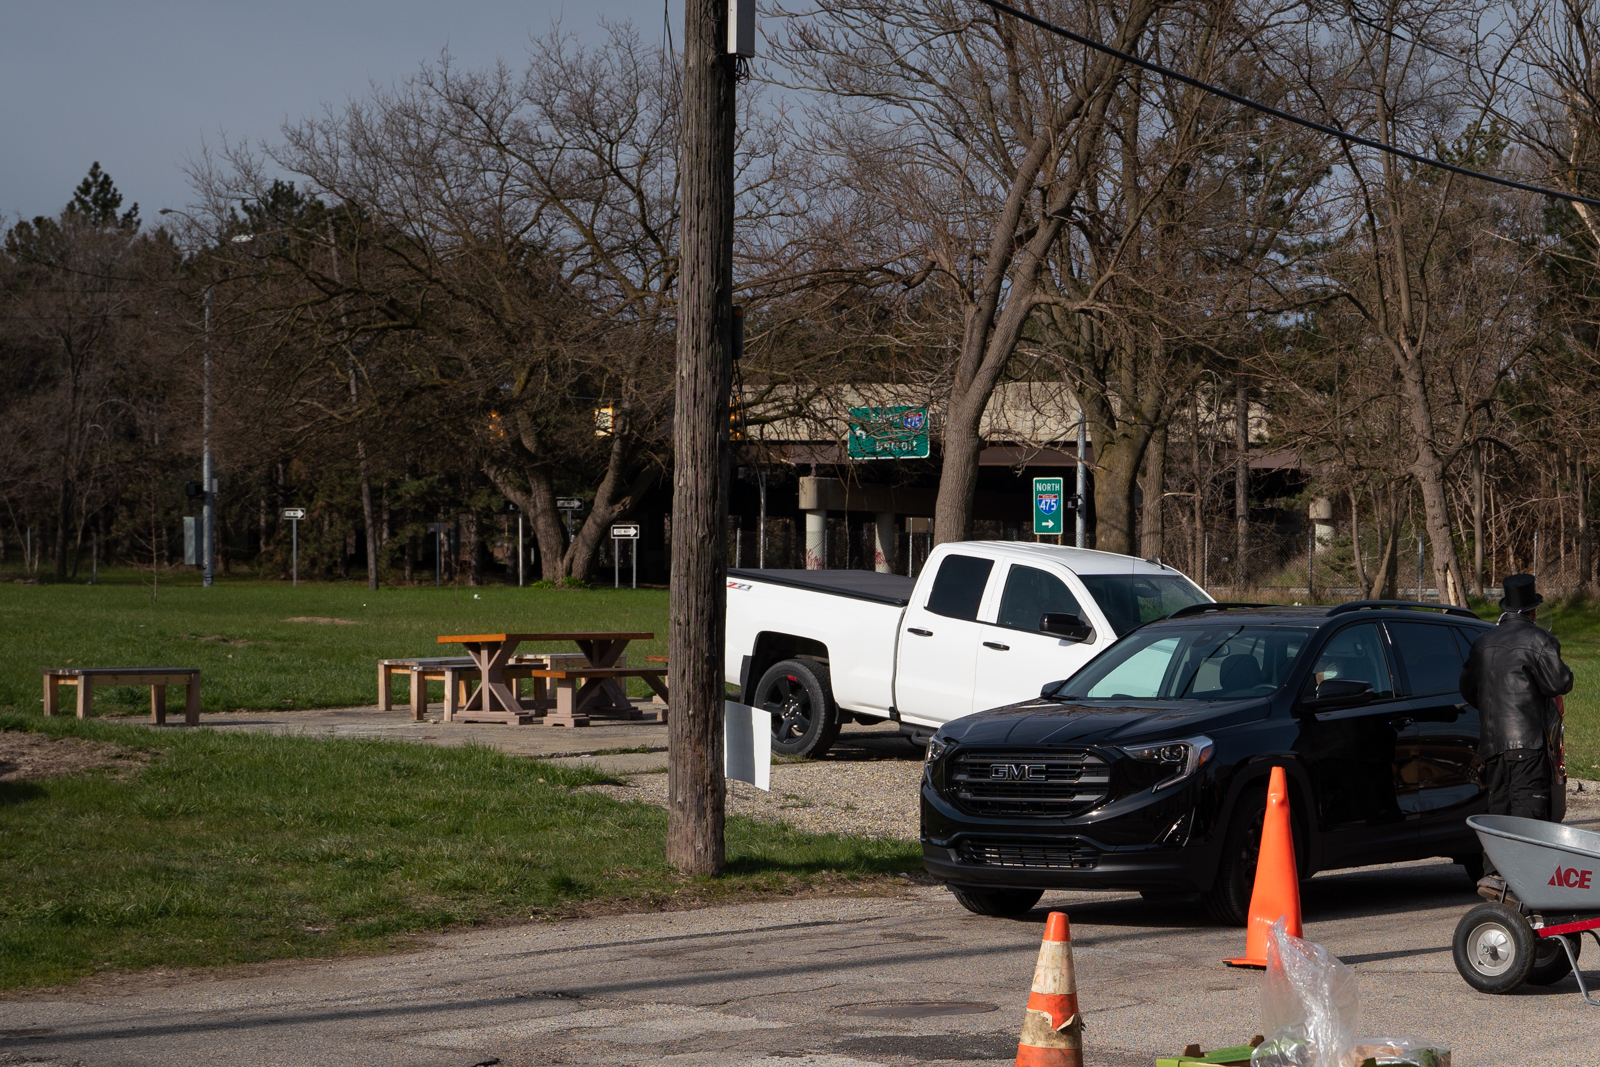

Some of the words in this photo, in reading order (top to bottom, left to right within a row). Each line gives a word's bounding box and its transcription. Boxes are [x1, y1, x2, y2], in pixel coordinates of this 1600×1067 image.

[1037, 483, 1059, 492] NORTH
[1039, 499, 1057, 510] 475
[990, 764, 1046, 781] GMC
[1547, 865, 1592, 889] ACE
